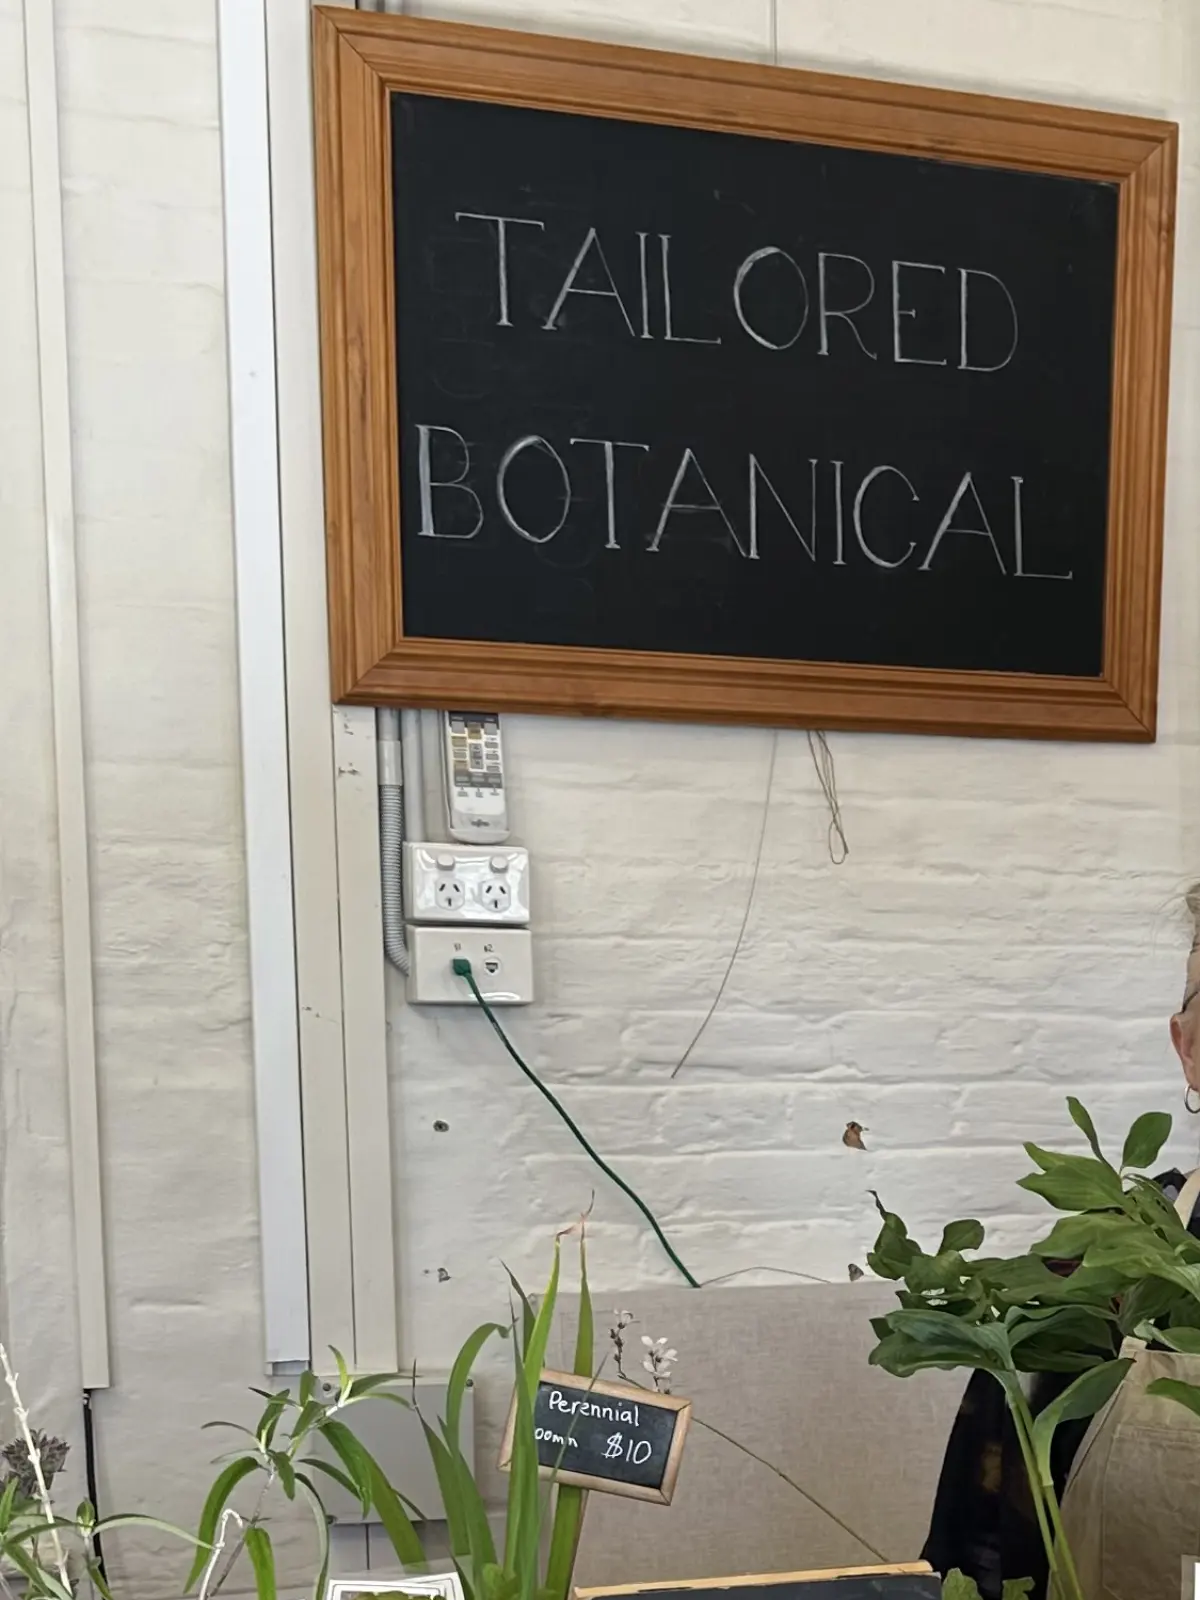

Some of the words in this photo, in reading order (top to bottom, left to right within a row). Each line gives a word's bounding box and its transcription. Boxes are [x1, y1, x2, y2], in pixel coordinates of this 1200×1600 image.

[455, 211, 1018, 372] TAILORED
[414, 424, 1073, 580] BOTANICAL
[549, 1390, 640, 1427] Perennial
[601, 1432, 652, 1464] $10
